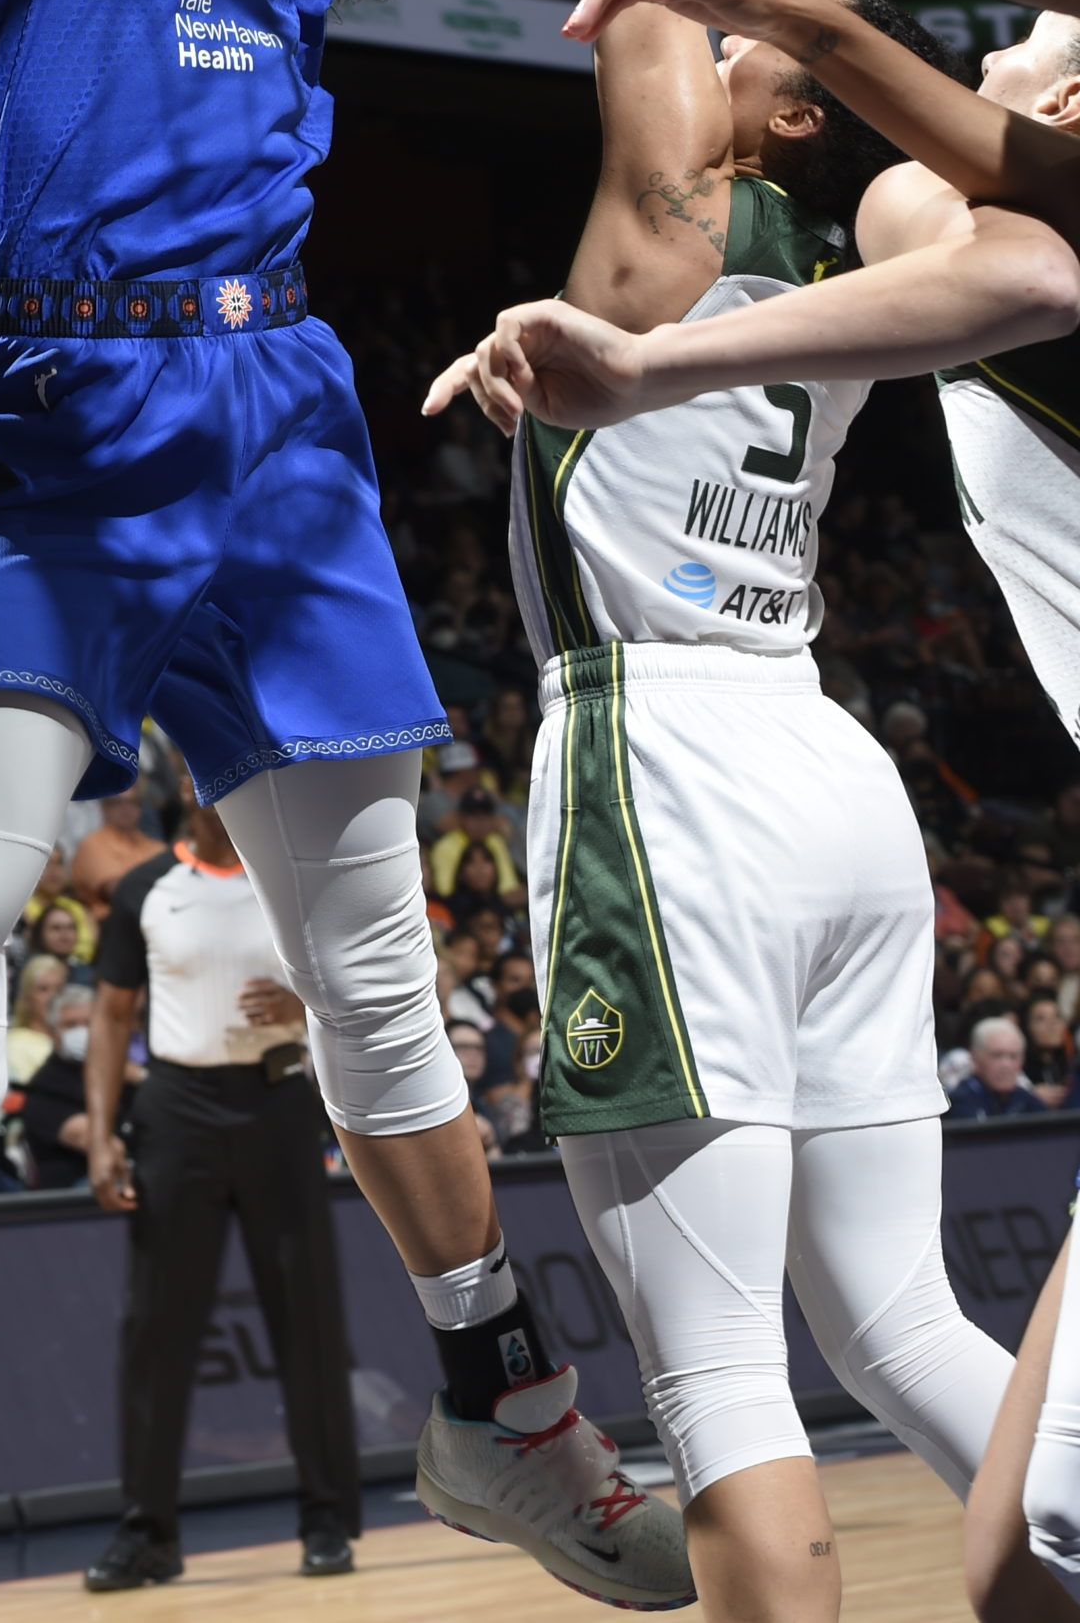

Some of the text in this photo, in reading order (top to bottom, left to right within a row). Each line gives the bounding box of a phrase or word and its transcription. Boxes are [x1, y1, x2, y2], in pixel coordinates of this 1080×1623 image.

[174, 12, 283, 50] NewHaven
[178, 42, 254, 72] Health
[683, 479, 812, 558] WILLIAMS
[719, 584, 803, 624] AT&T
